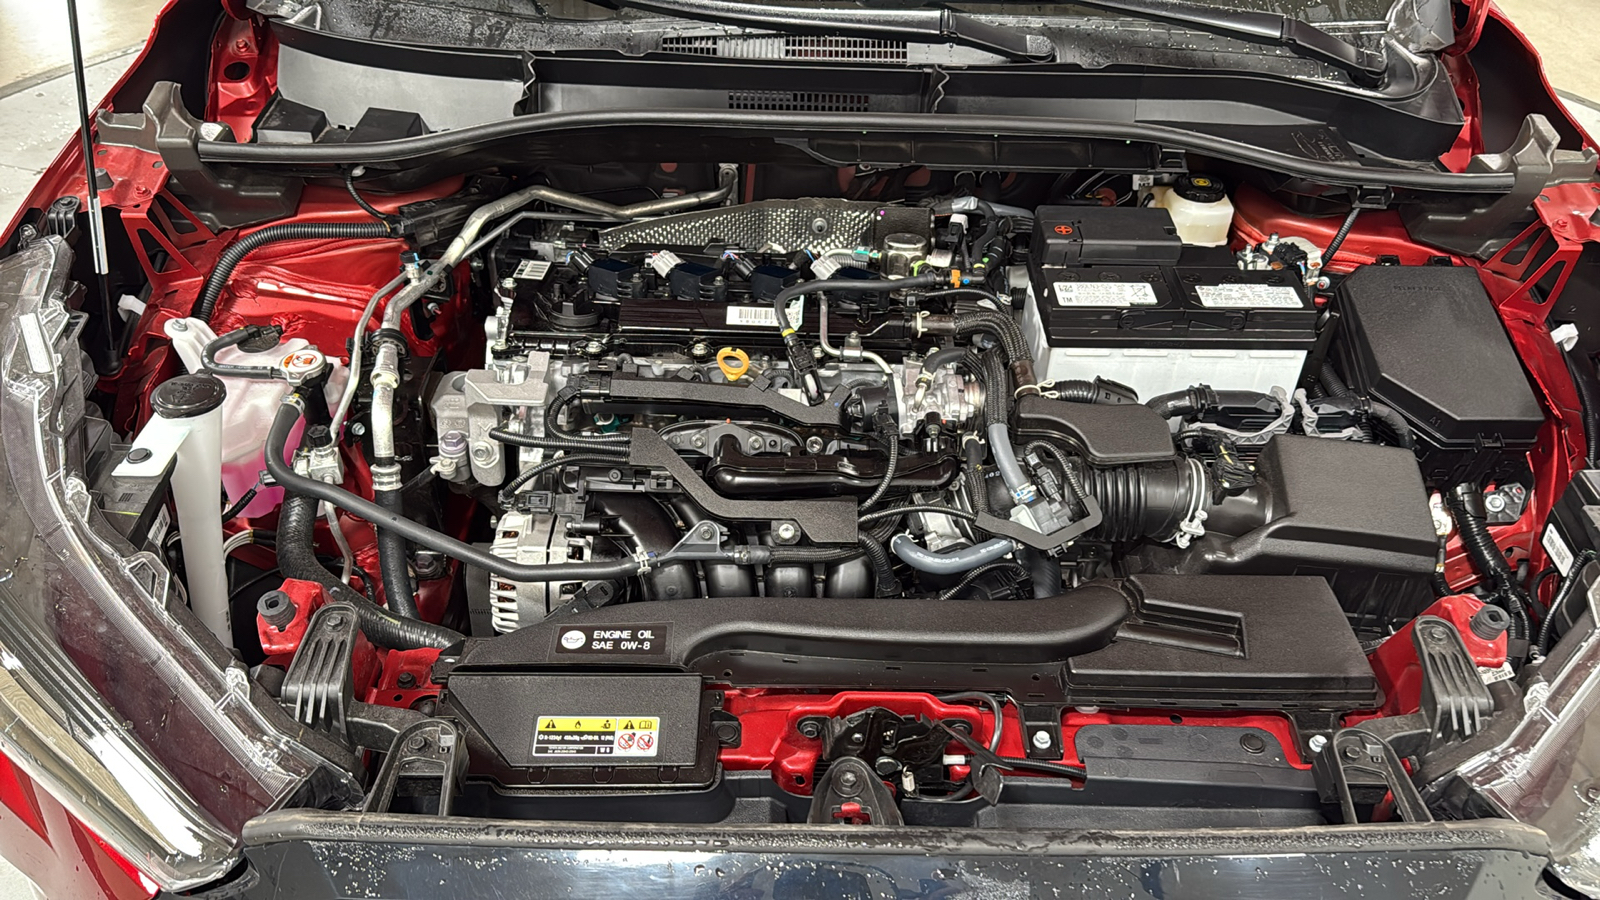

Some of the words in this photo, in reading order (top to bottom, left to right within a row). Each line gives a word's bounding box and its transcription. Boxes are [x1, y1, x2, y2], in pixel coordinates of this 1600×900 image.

[593, 630, 632, 639] ENGINE
[637, 630, 655, 639] OIL
[591, 641, 613, 650] SAE
[620, 641, 650, 650] 0W-8
